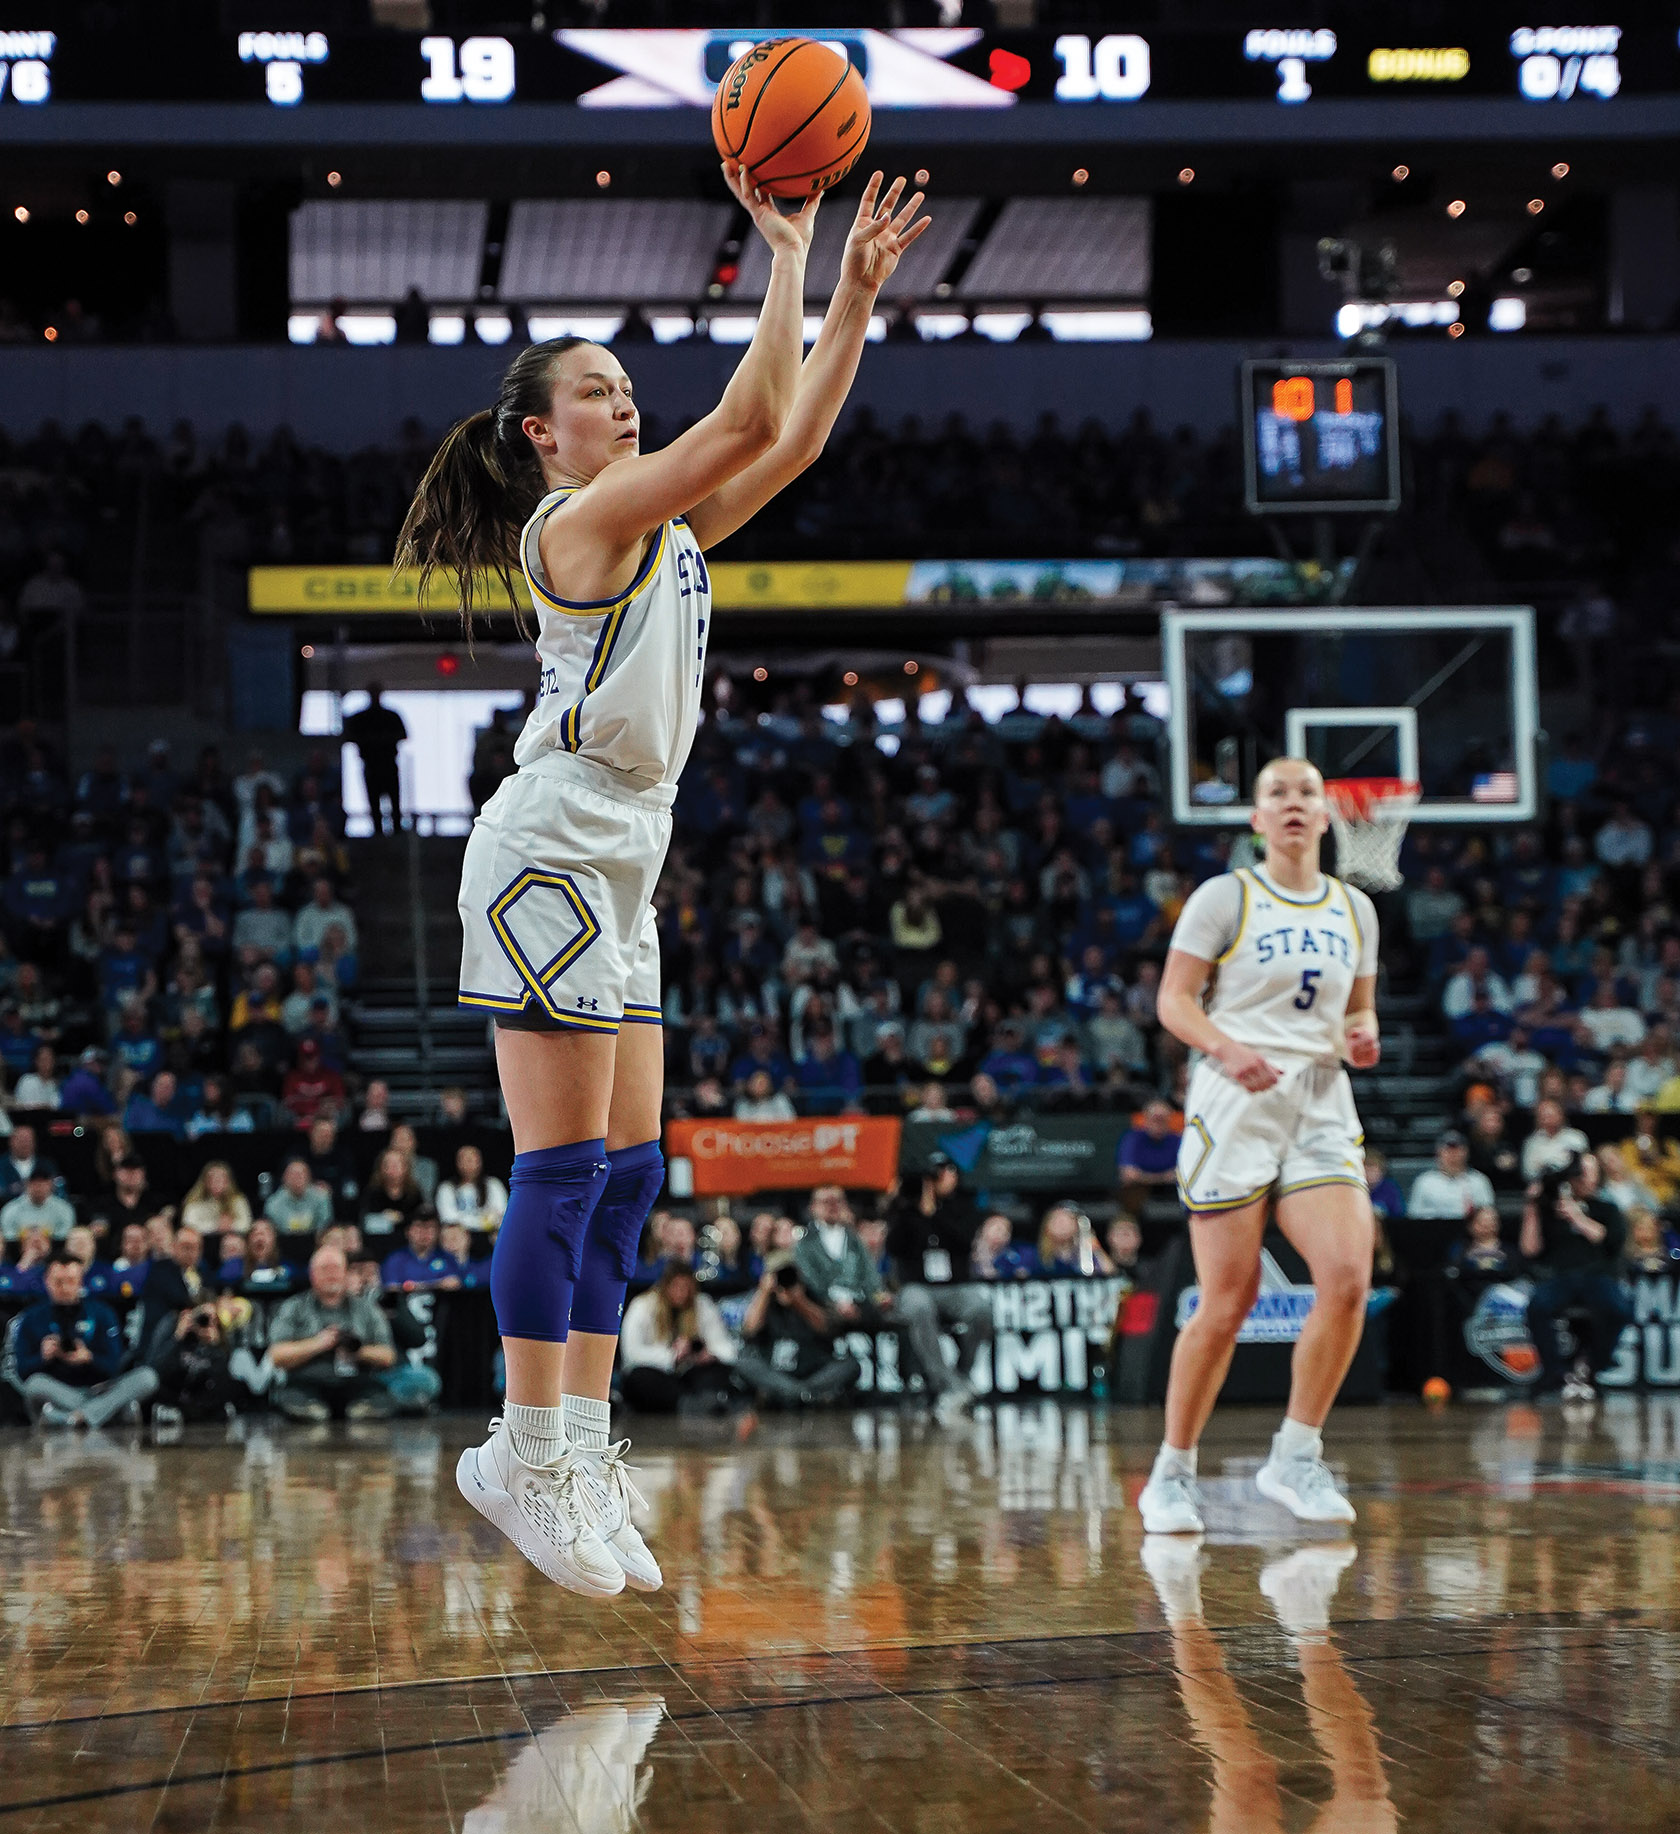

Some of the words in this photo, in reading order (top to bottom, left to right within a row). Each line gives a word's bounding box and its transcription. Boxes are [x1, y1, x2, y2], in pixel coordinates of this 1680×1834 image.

[238, 31, 328, 62] FOULS
[1244, 29, 1337, 60] FOULS
[1368, 48, 1469, 81] BONUS
[420, 36, 515, 102] 19
[1055, 34, 1151, 99] 10
[1276, 58, 1312, 103] 1
[1519, 55, 1620, 100] 0/4
[1294, 969, 1322, 1010] 5
